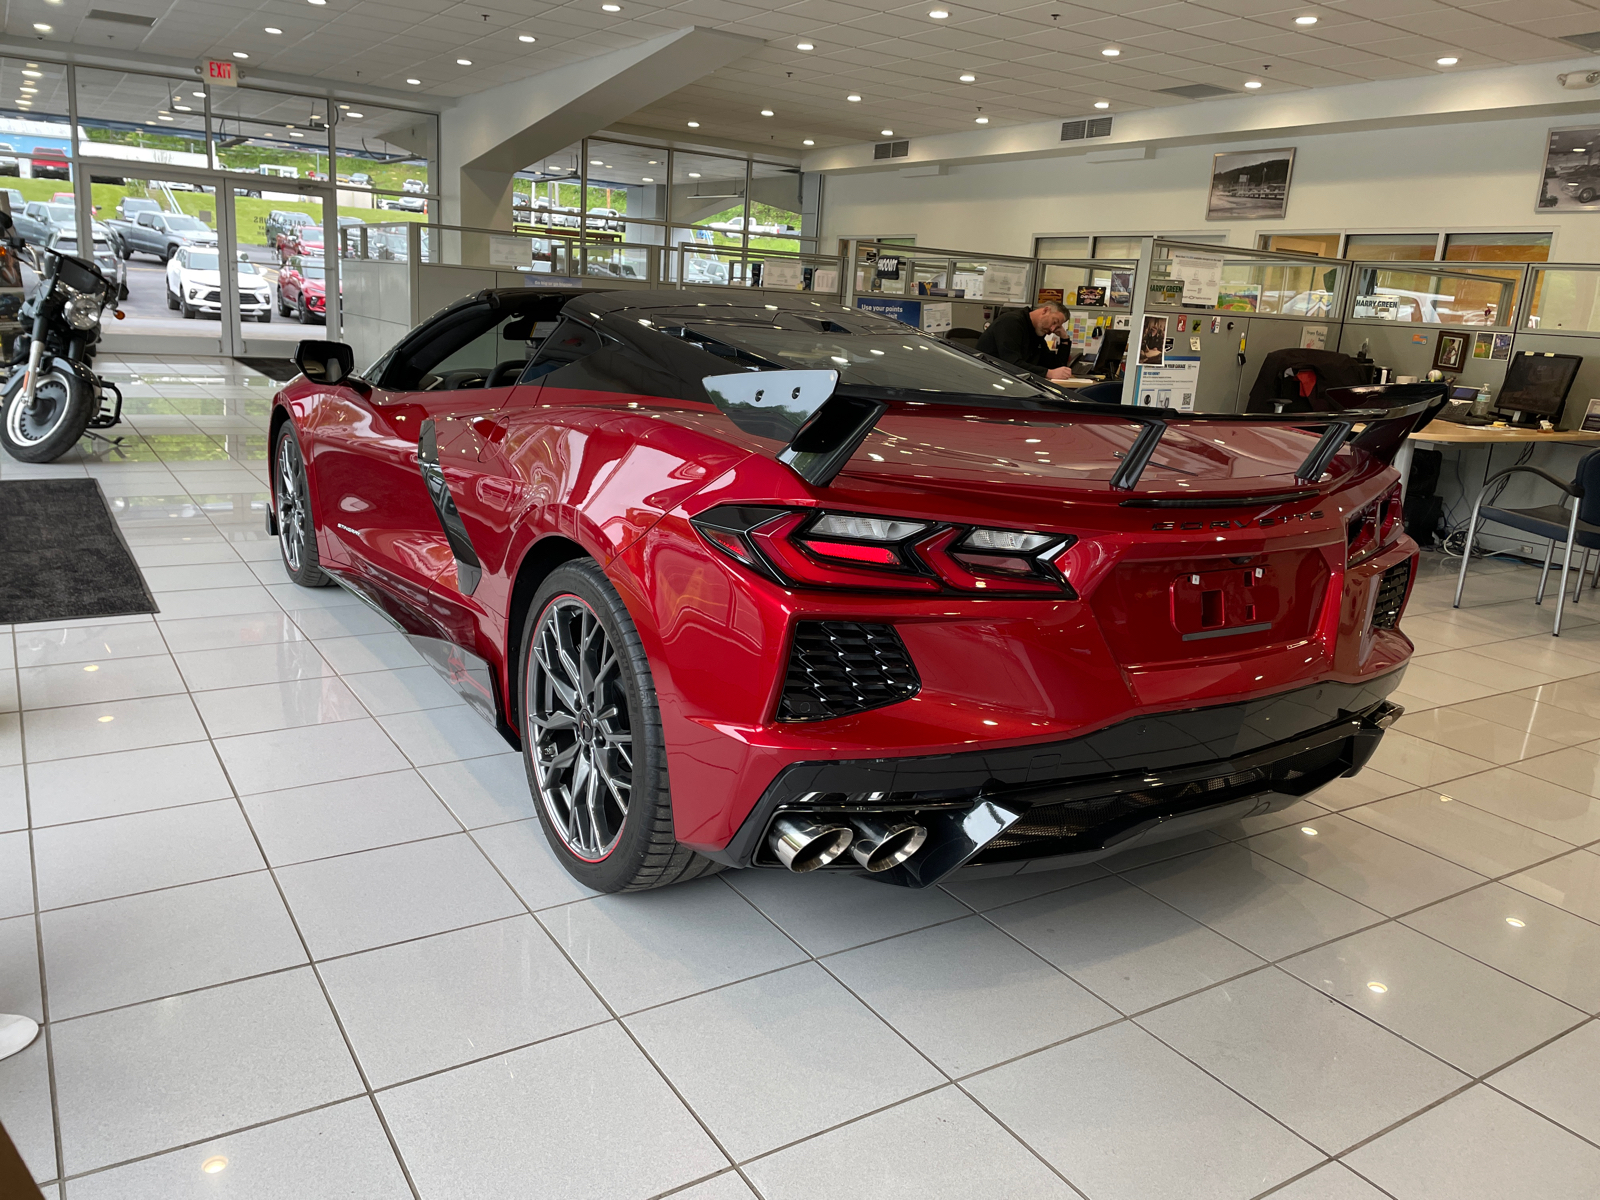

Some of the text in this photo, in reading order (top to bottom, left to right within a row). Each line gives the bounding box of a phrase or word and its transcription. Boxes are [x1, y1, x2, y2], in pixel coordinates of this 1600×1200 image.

[209, 61, 232, 79] EXIT
[1166, 285, 1183, 293] GREEN
[861, 303, 872, 311] Use
[885, 305, 903, 313] points
[1356, 299, 1398, 308] HARRY GREEN
[1151, 510, 1325, 531] CORVETTE
[611, 628, 638, 709] MICHELIN
